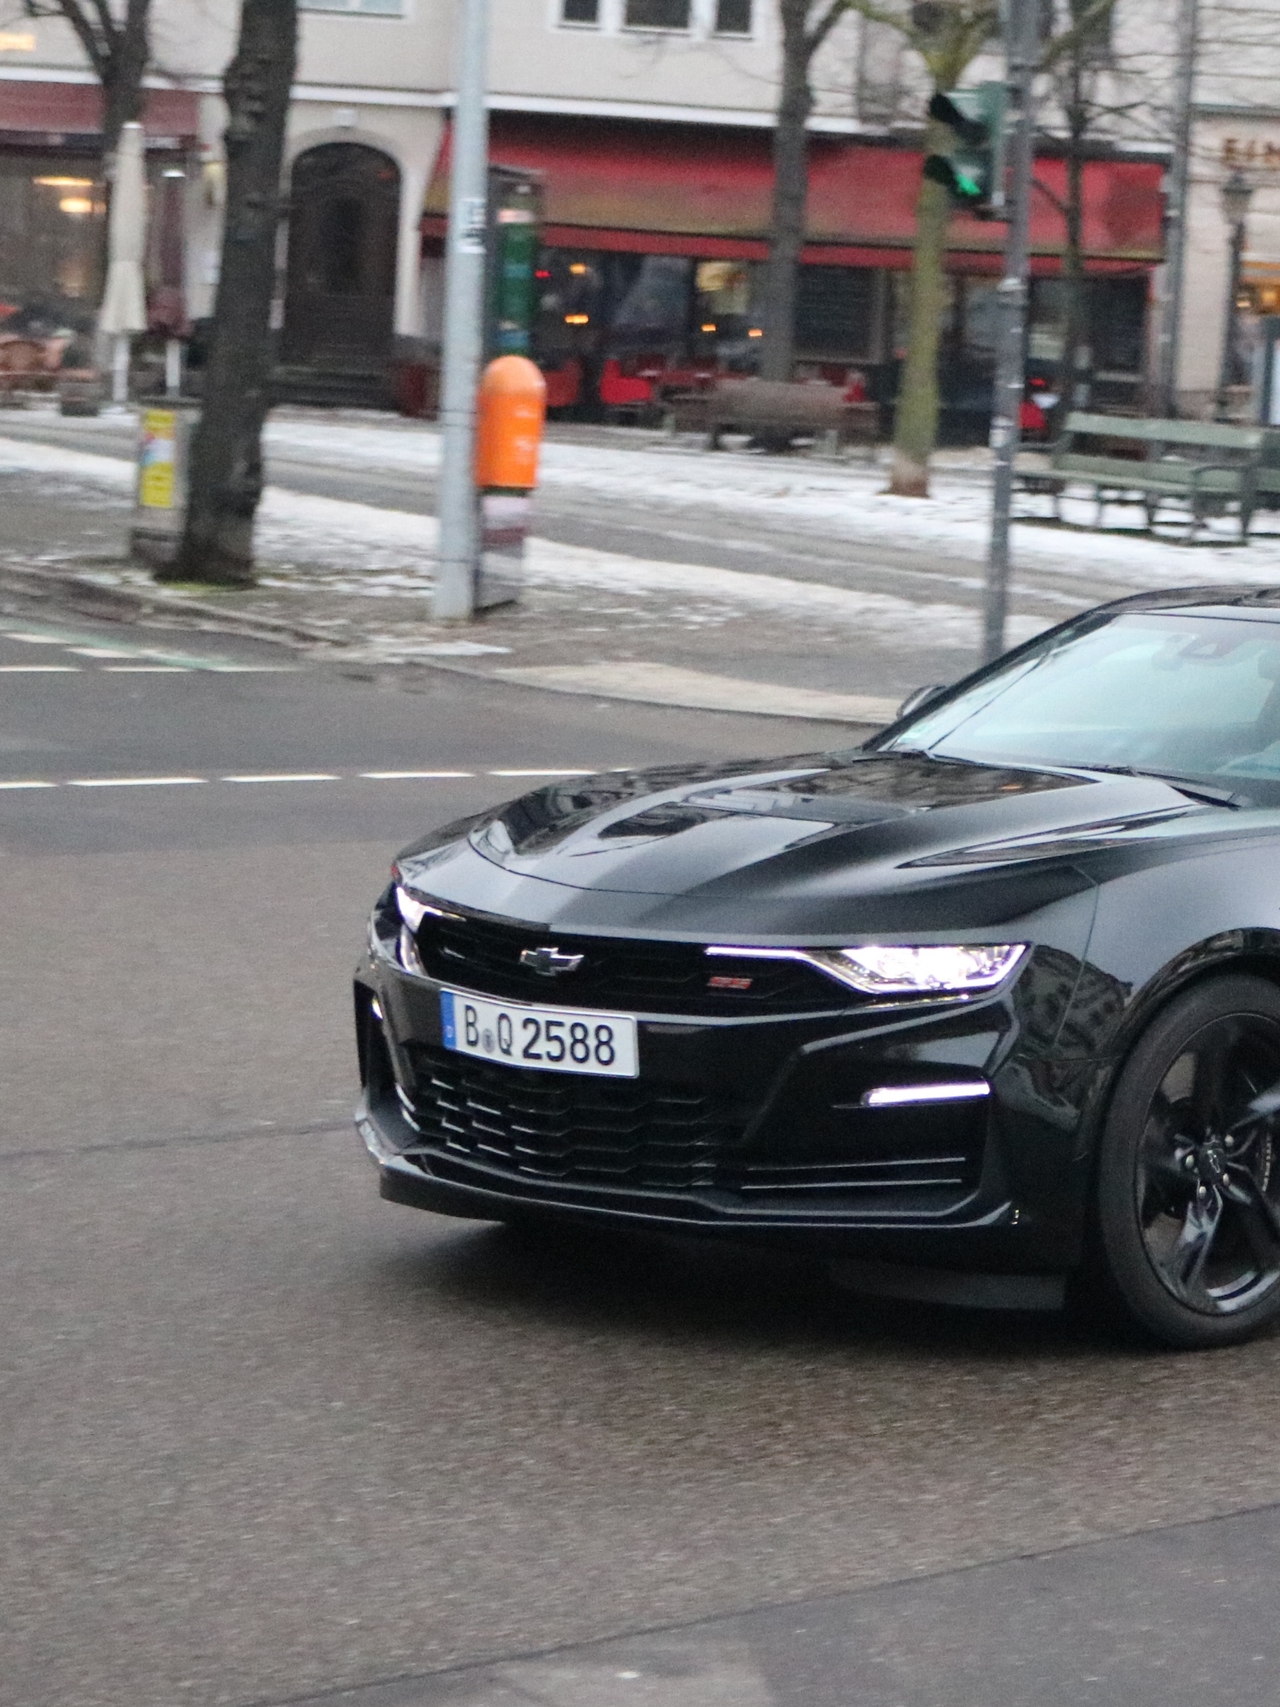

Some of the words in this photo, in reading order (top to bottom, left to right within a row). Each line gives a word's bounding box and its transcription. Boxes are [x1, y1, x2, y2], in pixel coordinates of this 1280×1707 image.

[464, 1004, 479, 1047] B
[497, 1012, 513, 1057] Q
[521, 1016, 616, 1067] 2588
